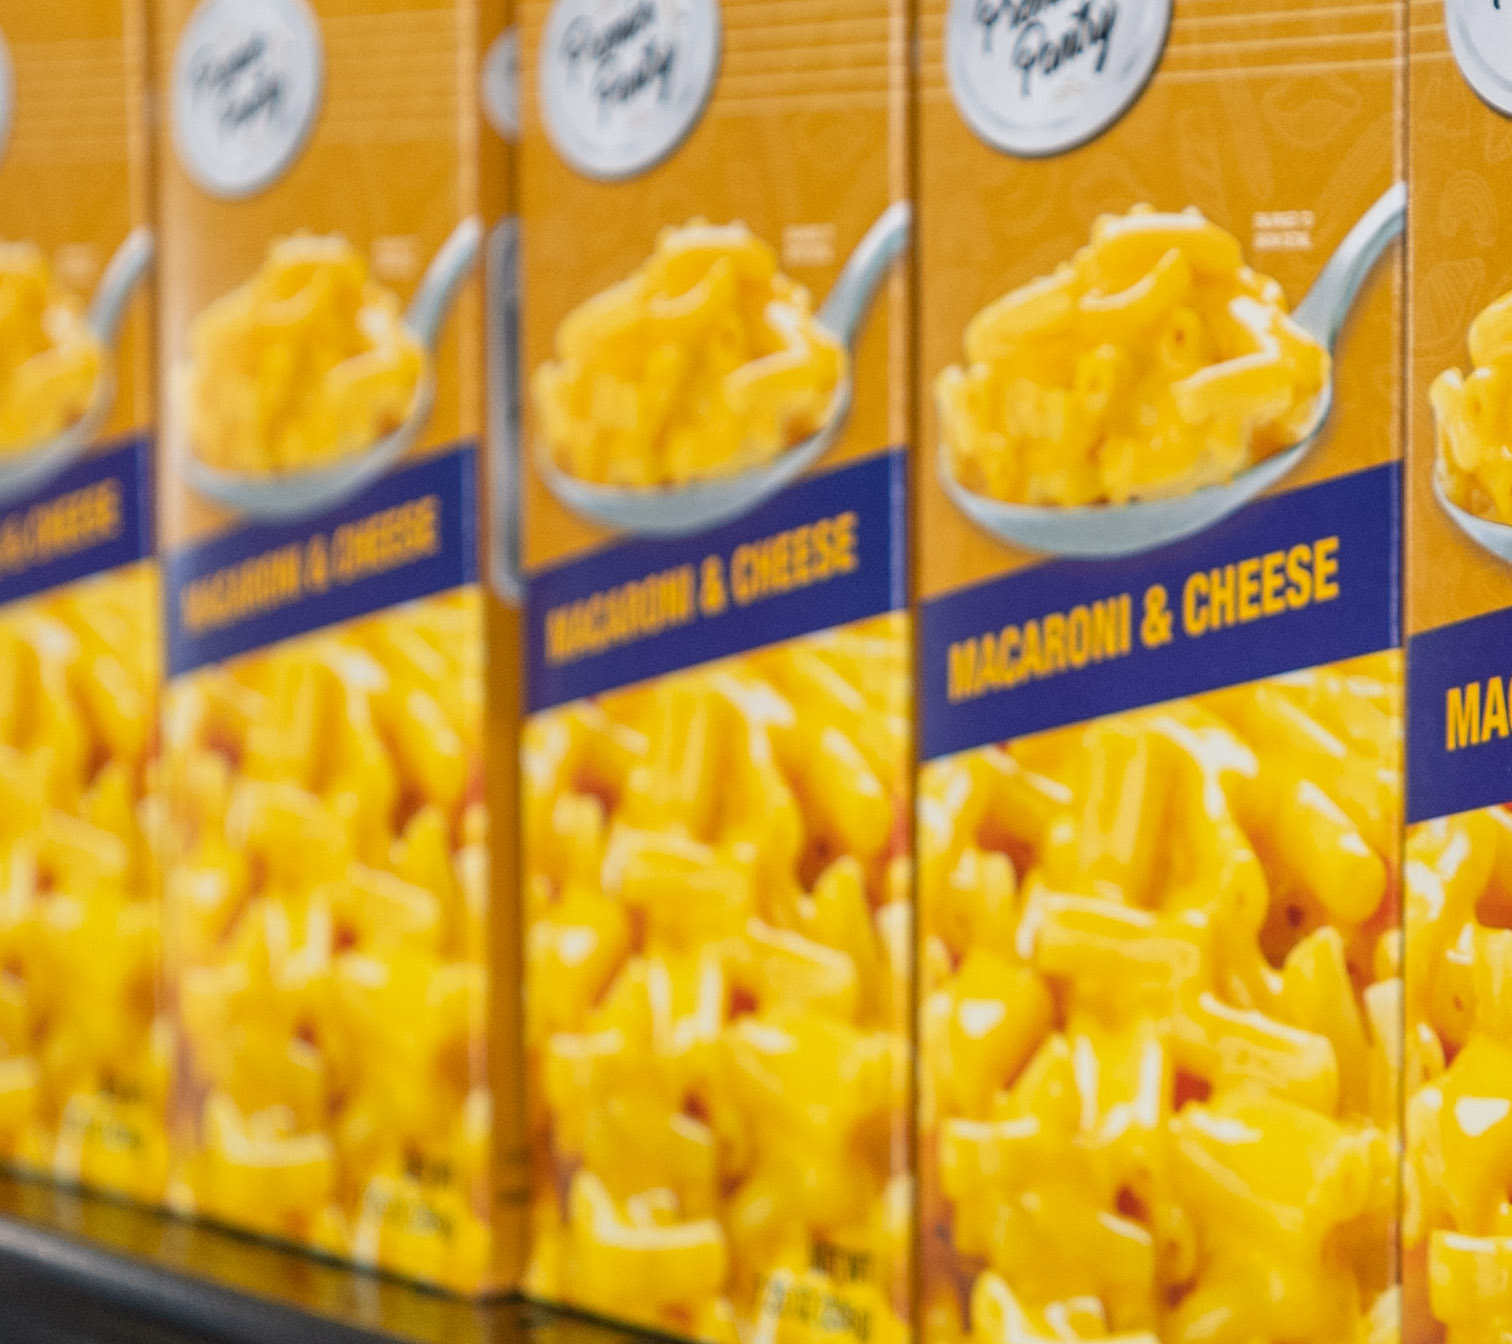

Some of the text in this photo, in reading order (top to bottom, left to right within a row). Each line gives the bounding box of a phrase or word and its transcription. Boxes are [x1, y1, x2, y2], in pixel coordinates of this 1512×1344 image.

[947, 536, 1340, 704] MACARONI & CHEESE
